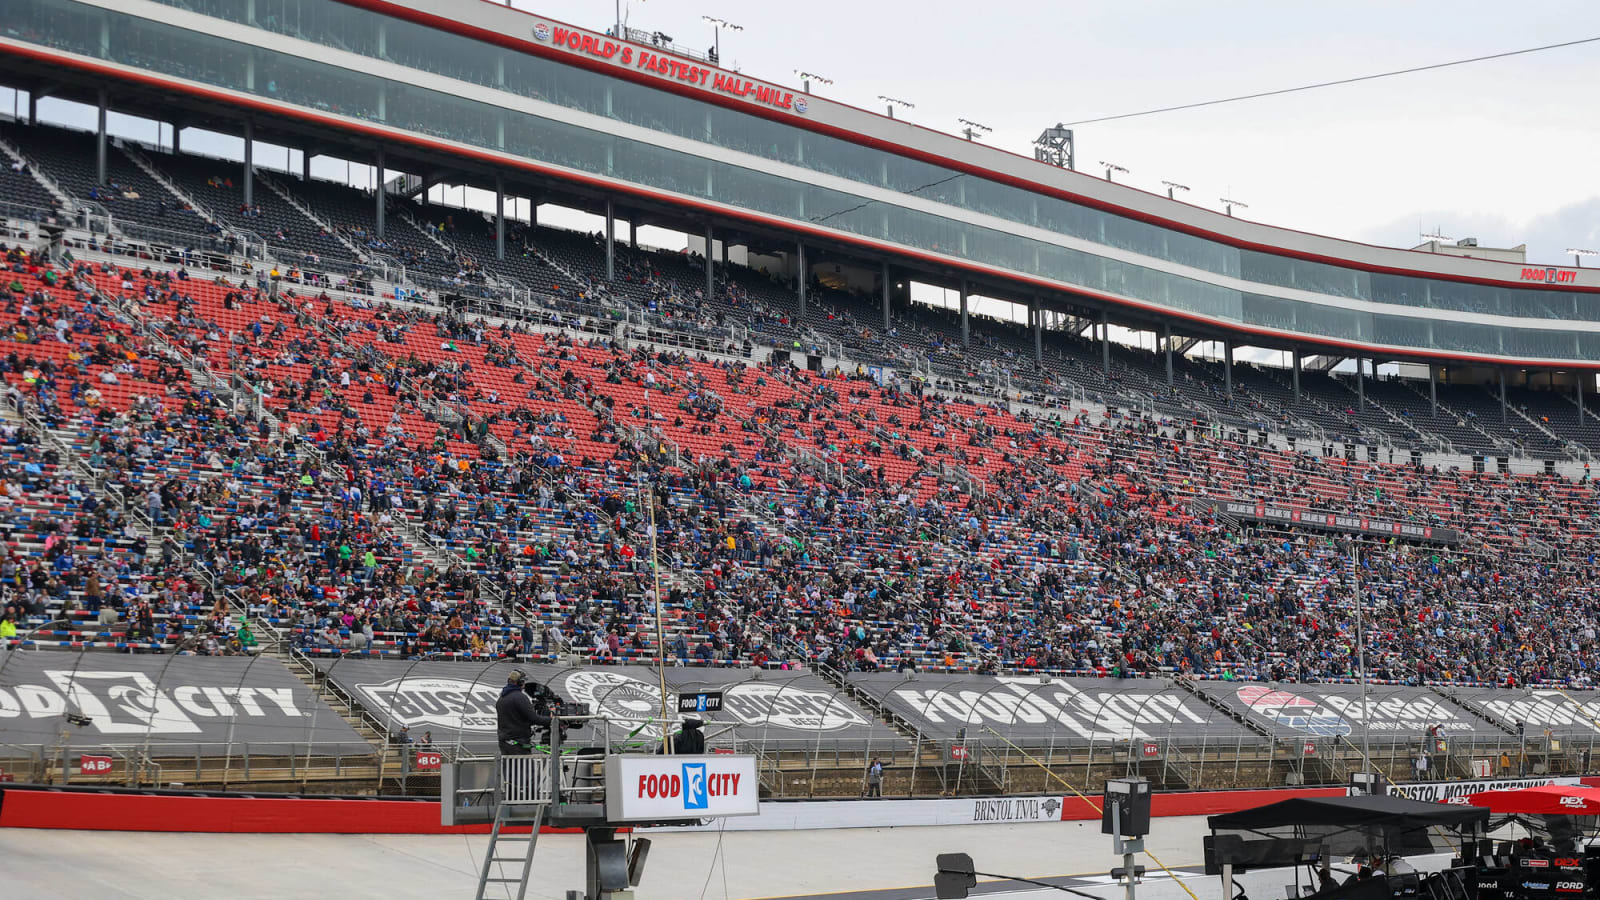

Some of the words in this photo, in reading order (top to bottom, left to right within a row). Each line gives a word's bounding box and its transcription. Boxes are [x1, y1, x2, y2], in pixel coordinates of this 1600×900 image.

[552, 26, 633, 63] WORLD'S
[638, 51, 711, 85] FASTEST
[712, 73, 793, 109] HALF-MILE
[1520, 268, 1546, 281] FOOD
[1556, 270, 1577, 283] CITY
[174, 686, 302, 717] CITY
[681, 698, 697, 708] FOOD
[706, 697, 720, 707] CITY
[725, 694, 855, 719] BUSH'S
[894, 689, 1047, 724] FOOD
[1098, 692, 1213, 724] CITY
[1318, 694, 1459, 719] Bristol
[788, 717, 826, 726] BEST
[86, 760, 96, 771] A
[97, 760, 106, 770] B
[421, 756, 429, 765] B
[430, 756, 437, 765] C
[638, 774, 680, 799] FOOD
[708, 773, 741, 796] CITY
[1390, 786, 1440, 802] BRISTOL
[1443, 783, 1485, 800] MOTOR
[1448, 796, 1471, 804] DEX
[1560, 796, 1585, 805] DEX
[974, 800, 1013, 821] BRISTOL
[1556, 881, 1584, 890] FORD
